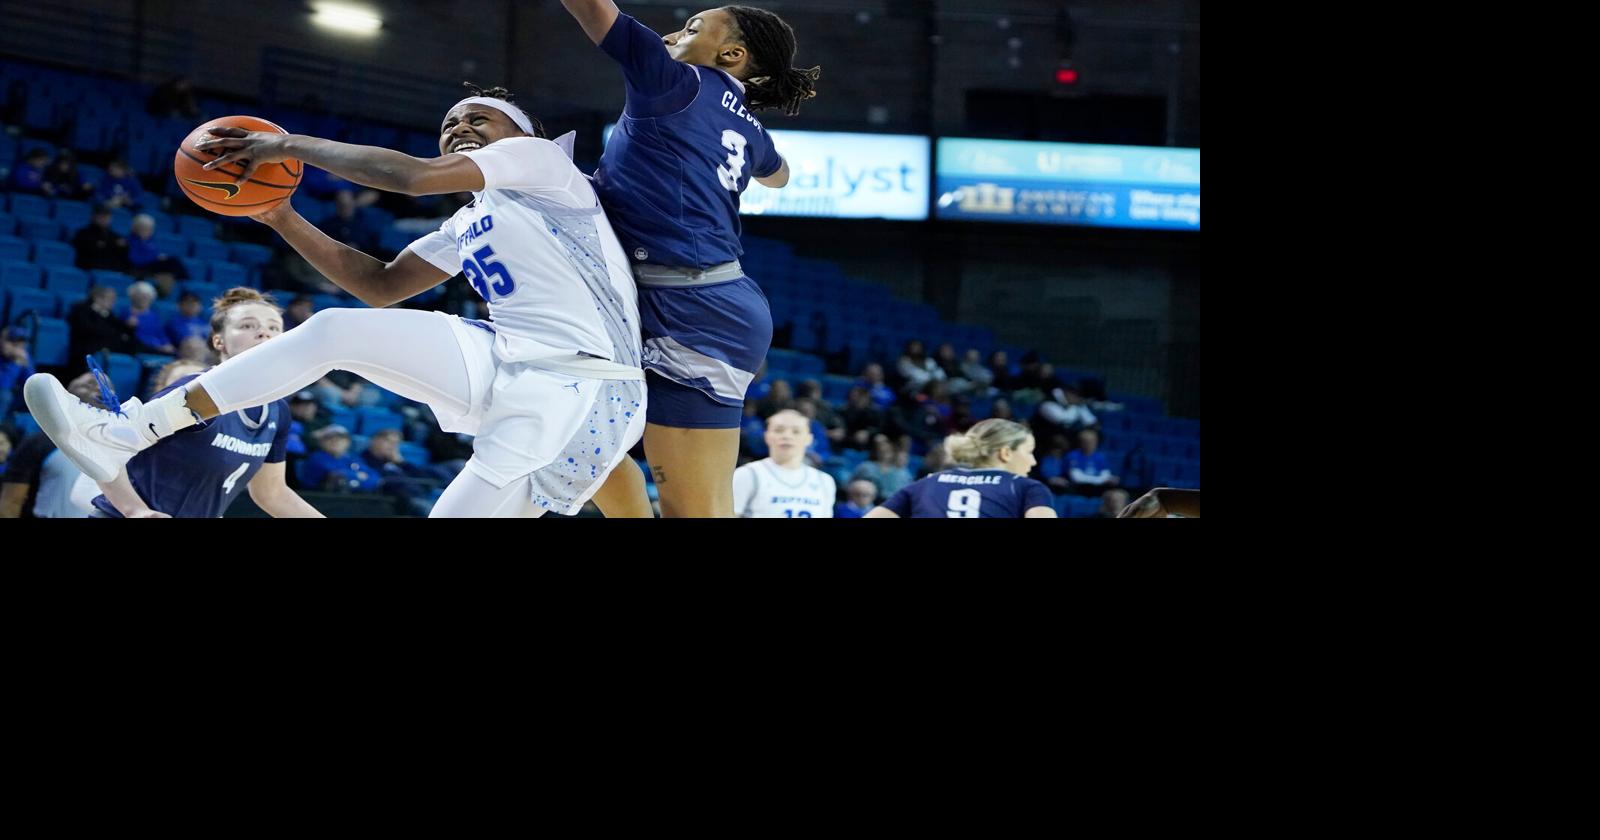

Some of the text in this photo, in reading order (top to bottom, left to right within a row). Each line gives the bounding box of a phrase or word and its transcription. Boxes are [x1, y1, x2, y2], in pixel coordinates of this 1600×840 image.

[717, 129, 748, 192] 3
[462, 244, 516, 303] 35
[222, 462, 251, 494] 4
[946, 488, 981, 518] 9
